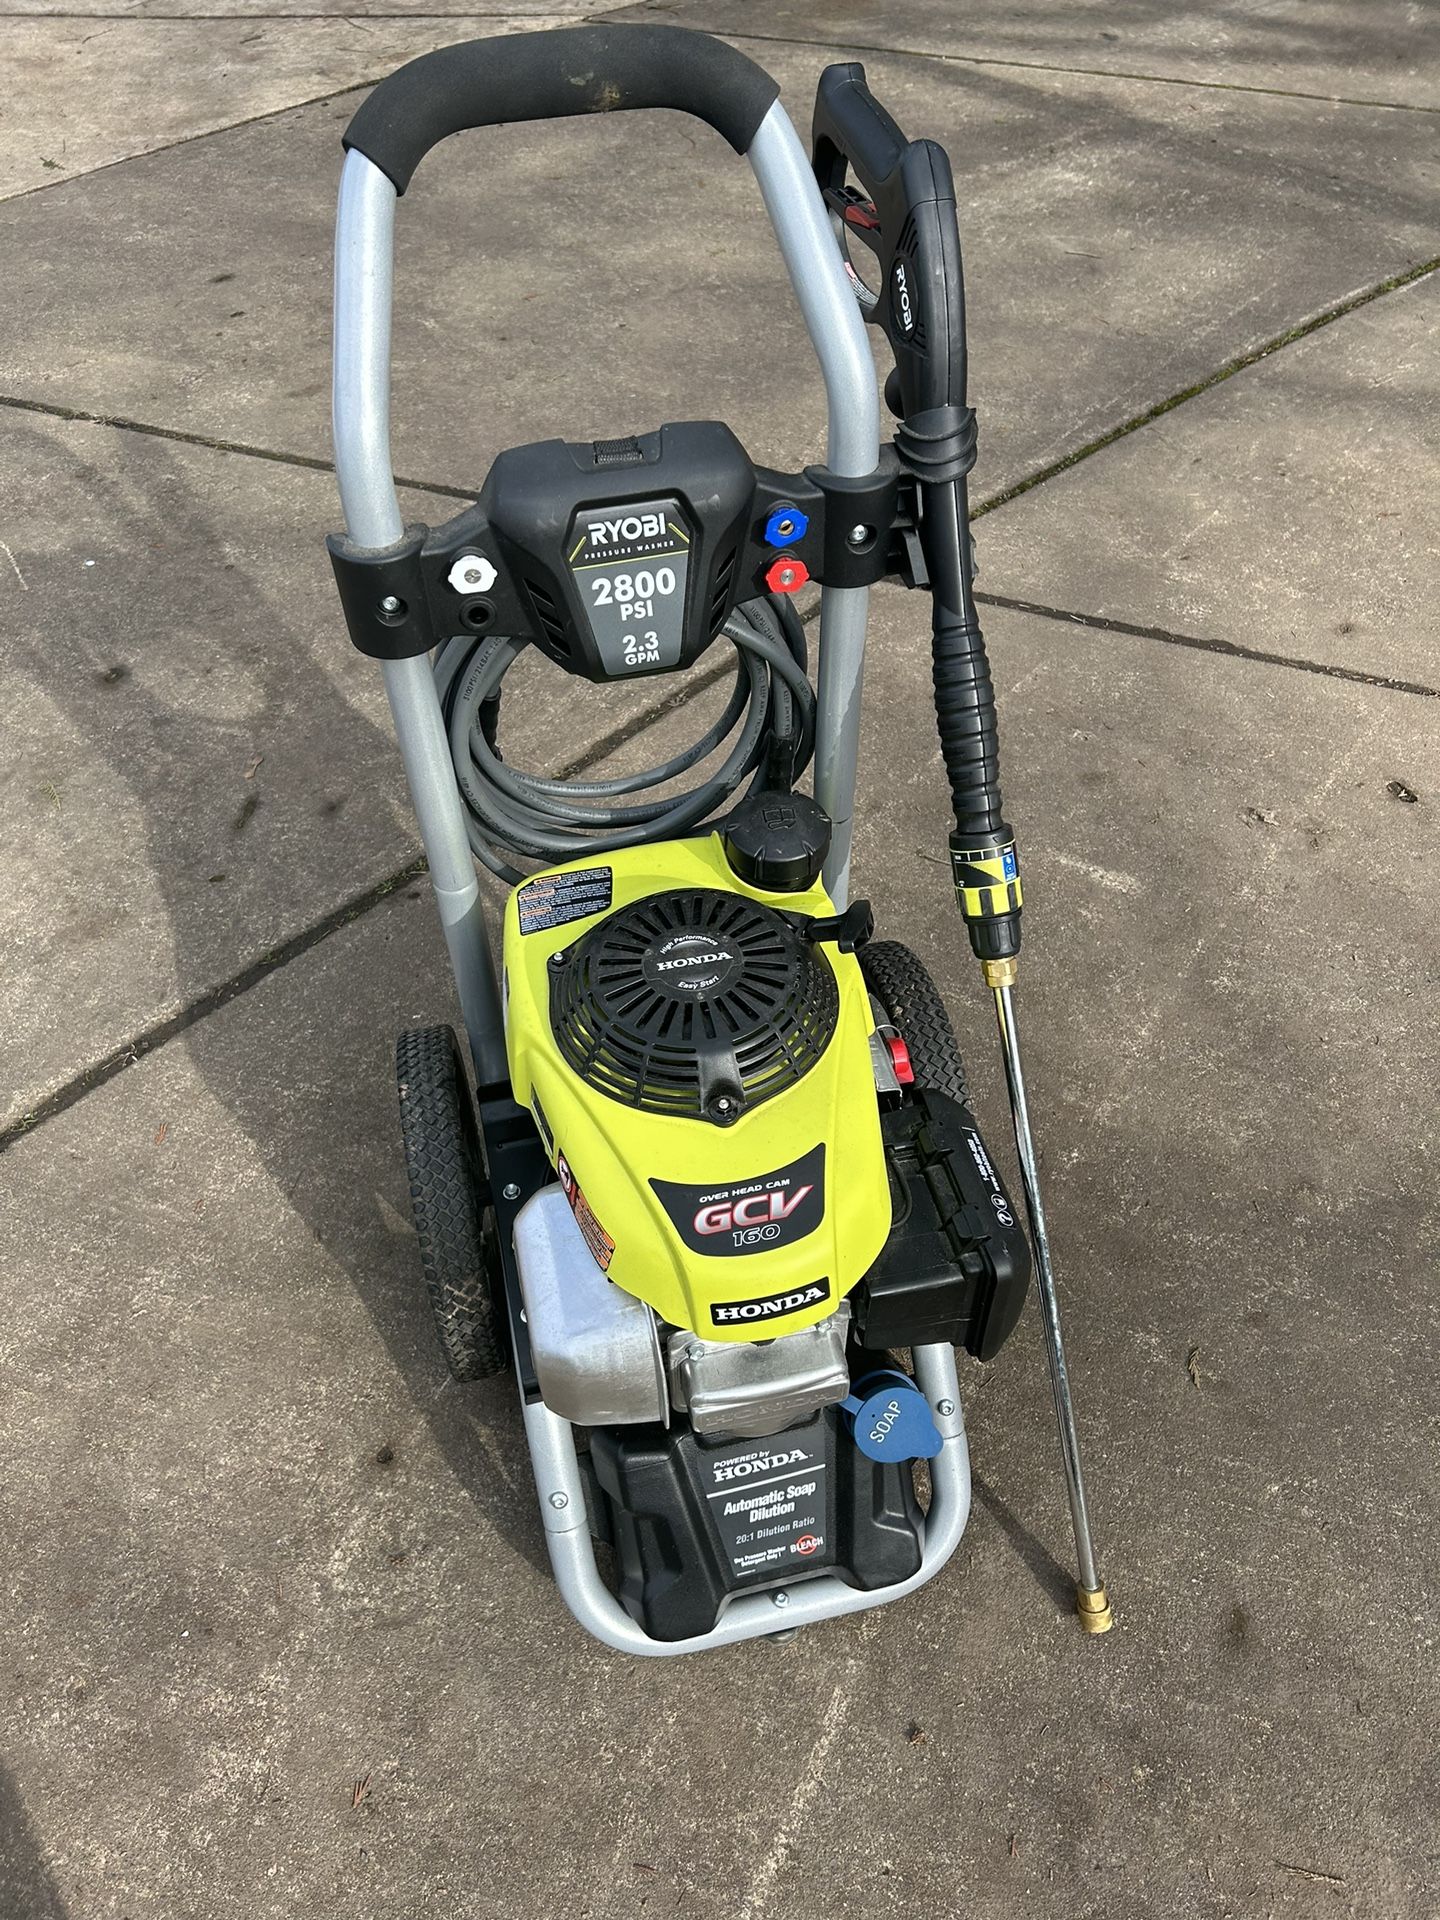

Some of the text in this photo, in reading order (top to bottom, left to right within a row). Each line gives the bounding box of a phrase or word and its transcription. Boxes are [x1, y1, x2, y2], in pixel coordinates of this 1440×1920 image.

[896, 264, 913, 332] RYOBI
[588, 512, 666, 546] RYOBI
[584, 540, 675, 560] PRESSURE WASHER
[591, 567, 676, 607] 2800
[619, 599, 654, 622] PSI
[622, 631, 659, 654] 2.3
[625, 650, 660, 666] GPM
[660, 934, 719, 955] High Performance
[656, 951, 734, 972] HONDA
[677, 975, 720, 991] Easy Start
[699, 1178, 791, 1204] OVER HEAD CAM
[693, 1184, 814, 1235] GCV
[732, 1223, 781, 1248] 160
[715, 1286, 826, 1321] HONDA
[869, 1400, 901, 1443] SOAP
[713, 1450, 770, 1469] POWERED by
[713, 1448, 809, 1483] HONDA
[723, 1481, 816, 1516] Automatic Soap
[749, 1501, 795, 1523] Dilution
[735, 1516, 815, 1545] 20:1 Dilution Ratio
[790, 1536, 824, 1553] BLEACH
